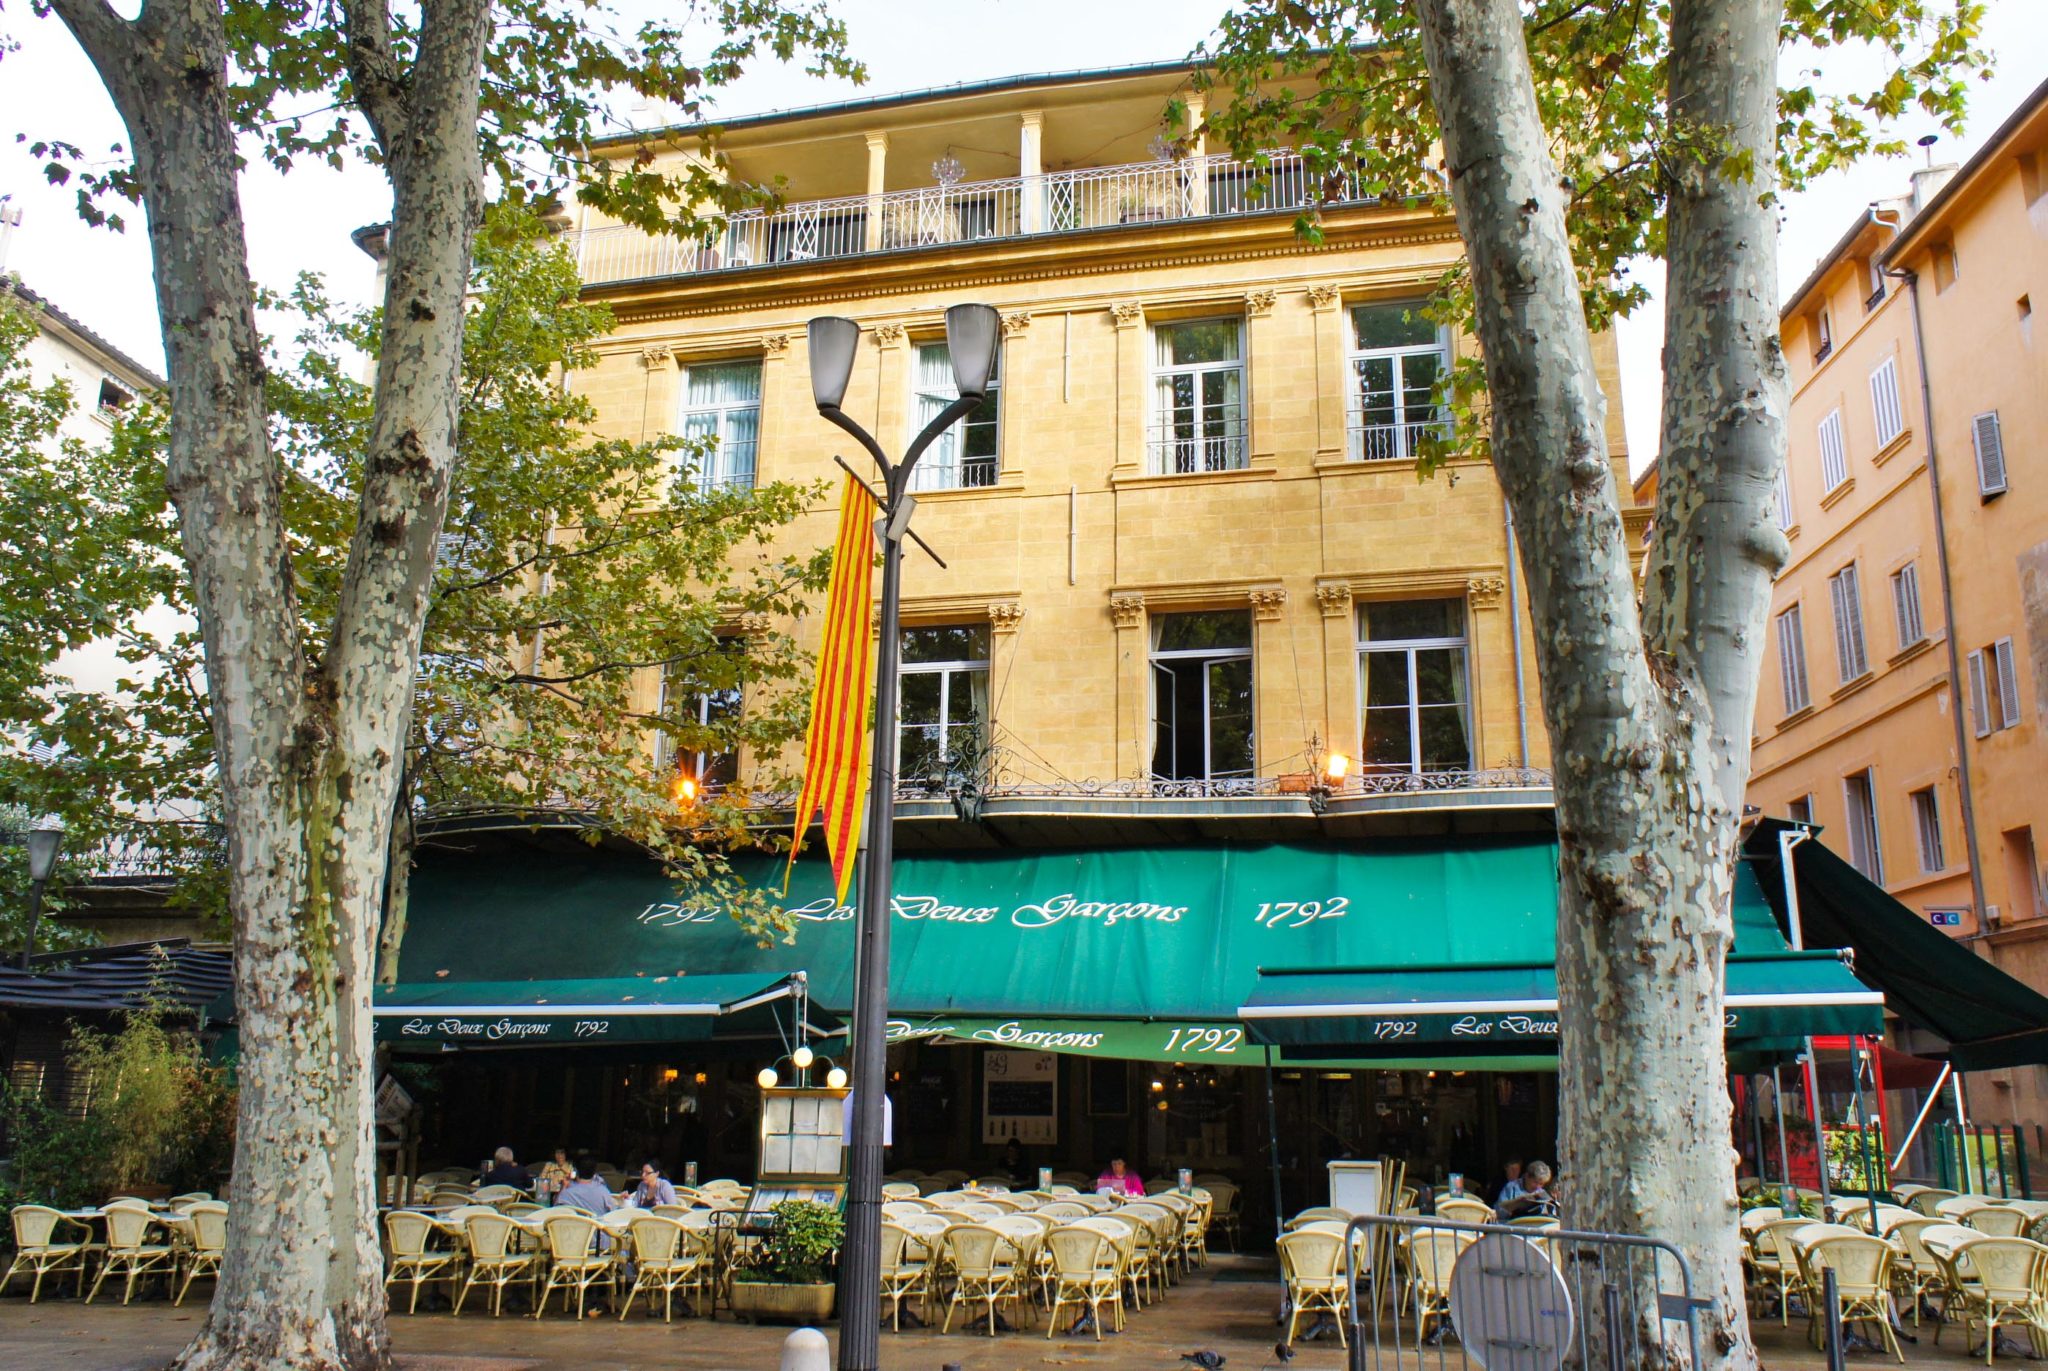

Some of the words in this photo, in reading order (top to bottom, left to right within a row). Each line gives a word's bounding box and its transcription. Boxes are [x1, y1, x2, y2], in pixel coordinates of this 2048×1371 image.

[637, 902, 721, 927] 1792
[783, 898, 857, 922] Les
[889, 893, 999, 923] Deux
[1011, 893, 1188, 927] Garçons
[1254, 896, 1350, 928] 1792
[401, 1018, 433, 1035] Les
[437, 1018, 484, 1035] Deux
[486, 1017, 552, 1040] Garçons
[574, 1020, 609, 1038] 1792
[972, 1021, 1104, 1048] Garçons
[1164, 1027, 1242, 1053] 1792
[1373, 1021, 1418, 1040] 1792
[1451, 1015, 1493, 1035] Les
